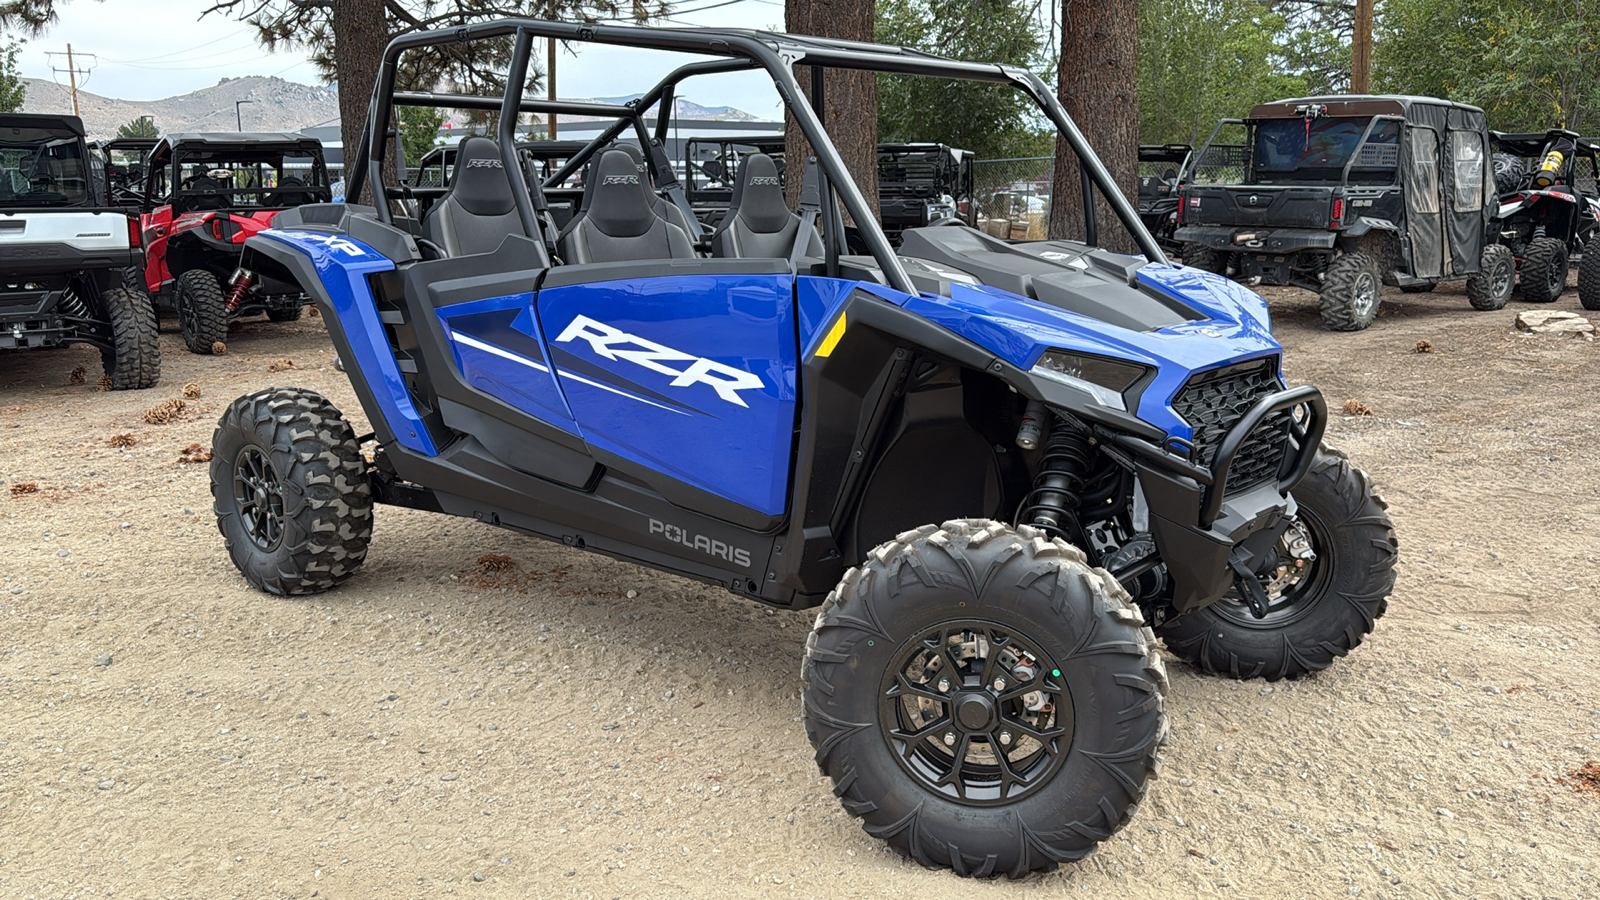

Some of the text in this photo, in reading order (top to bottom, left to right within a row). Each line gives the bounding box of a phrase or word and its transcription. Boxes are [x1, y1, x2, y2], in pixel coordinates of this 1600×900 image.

[466, 158, 503, 168] RZR
[602, 174, 639, 185] RZR
[749, 176, 778, 186] RZR
[555, 313, 765, 409] RZR
[648, 517, 752, 568] POLARIS
